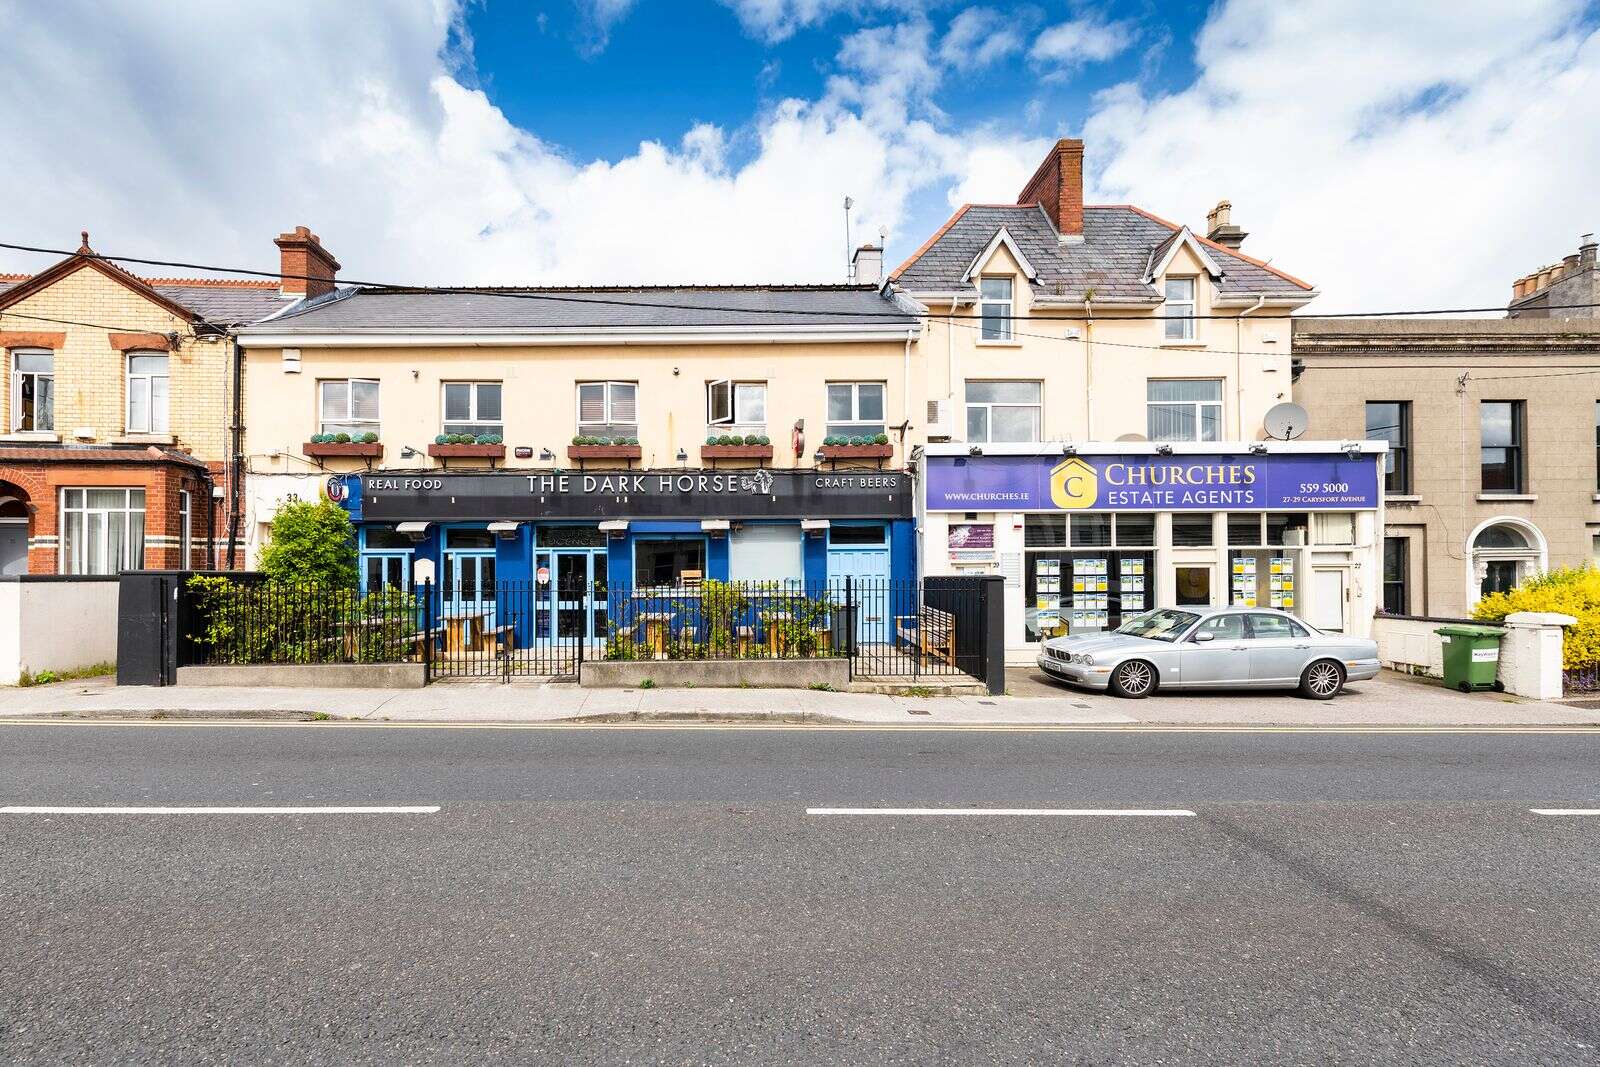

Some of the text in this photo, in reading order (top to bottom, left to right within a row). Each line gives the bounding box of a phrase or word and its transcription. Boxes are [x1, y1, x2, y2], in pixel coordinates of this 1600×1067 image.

[1104, 463, 1257, 485] CHURCHES
[368, 479, 443, 490] REAL FOOD
[526, 475, 738, 493] THE DARK HORSE
[815, 476, 897, 488] CRAFT BEERS
[1064, 476, 1084, 498] C
[1299, 482, 1349, 494] 559 5000
[944, 492, 1030, 502] WWW.CHURCHES.IE
[1108, 490, 1255, 505] ESTATE AGENTS
